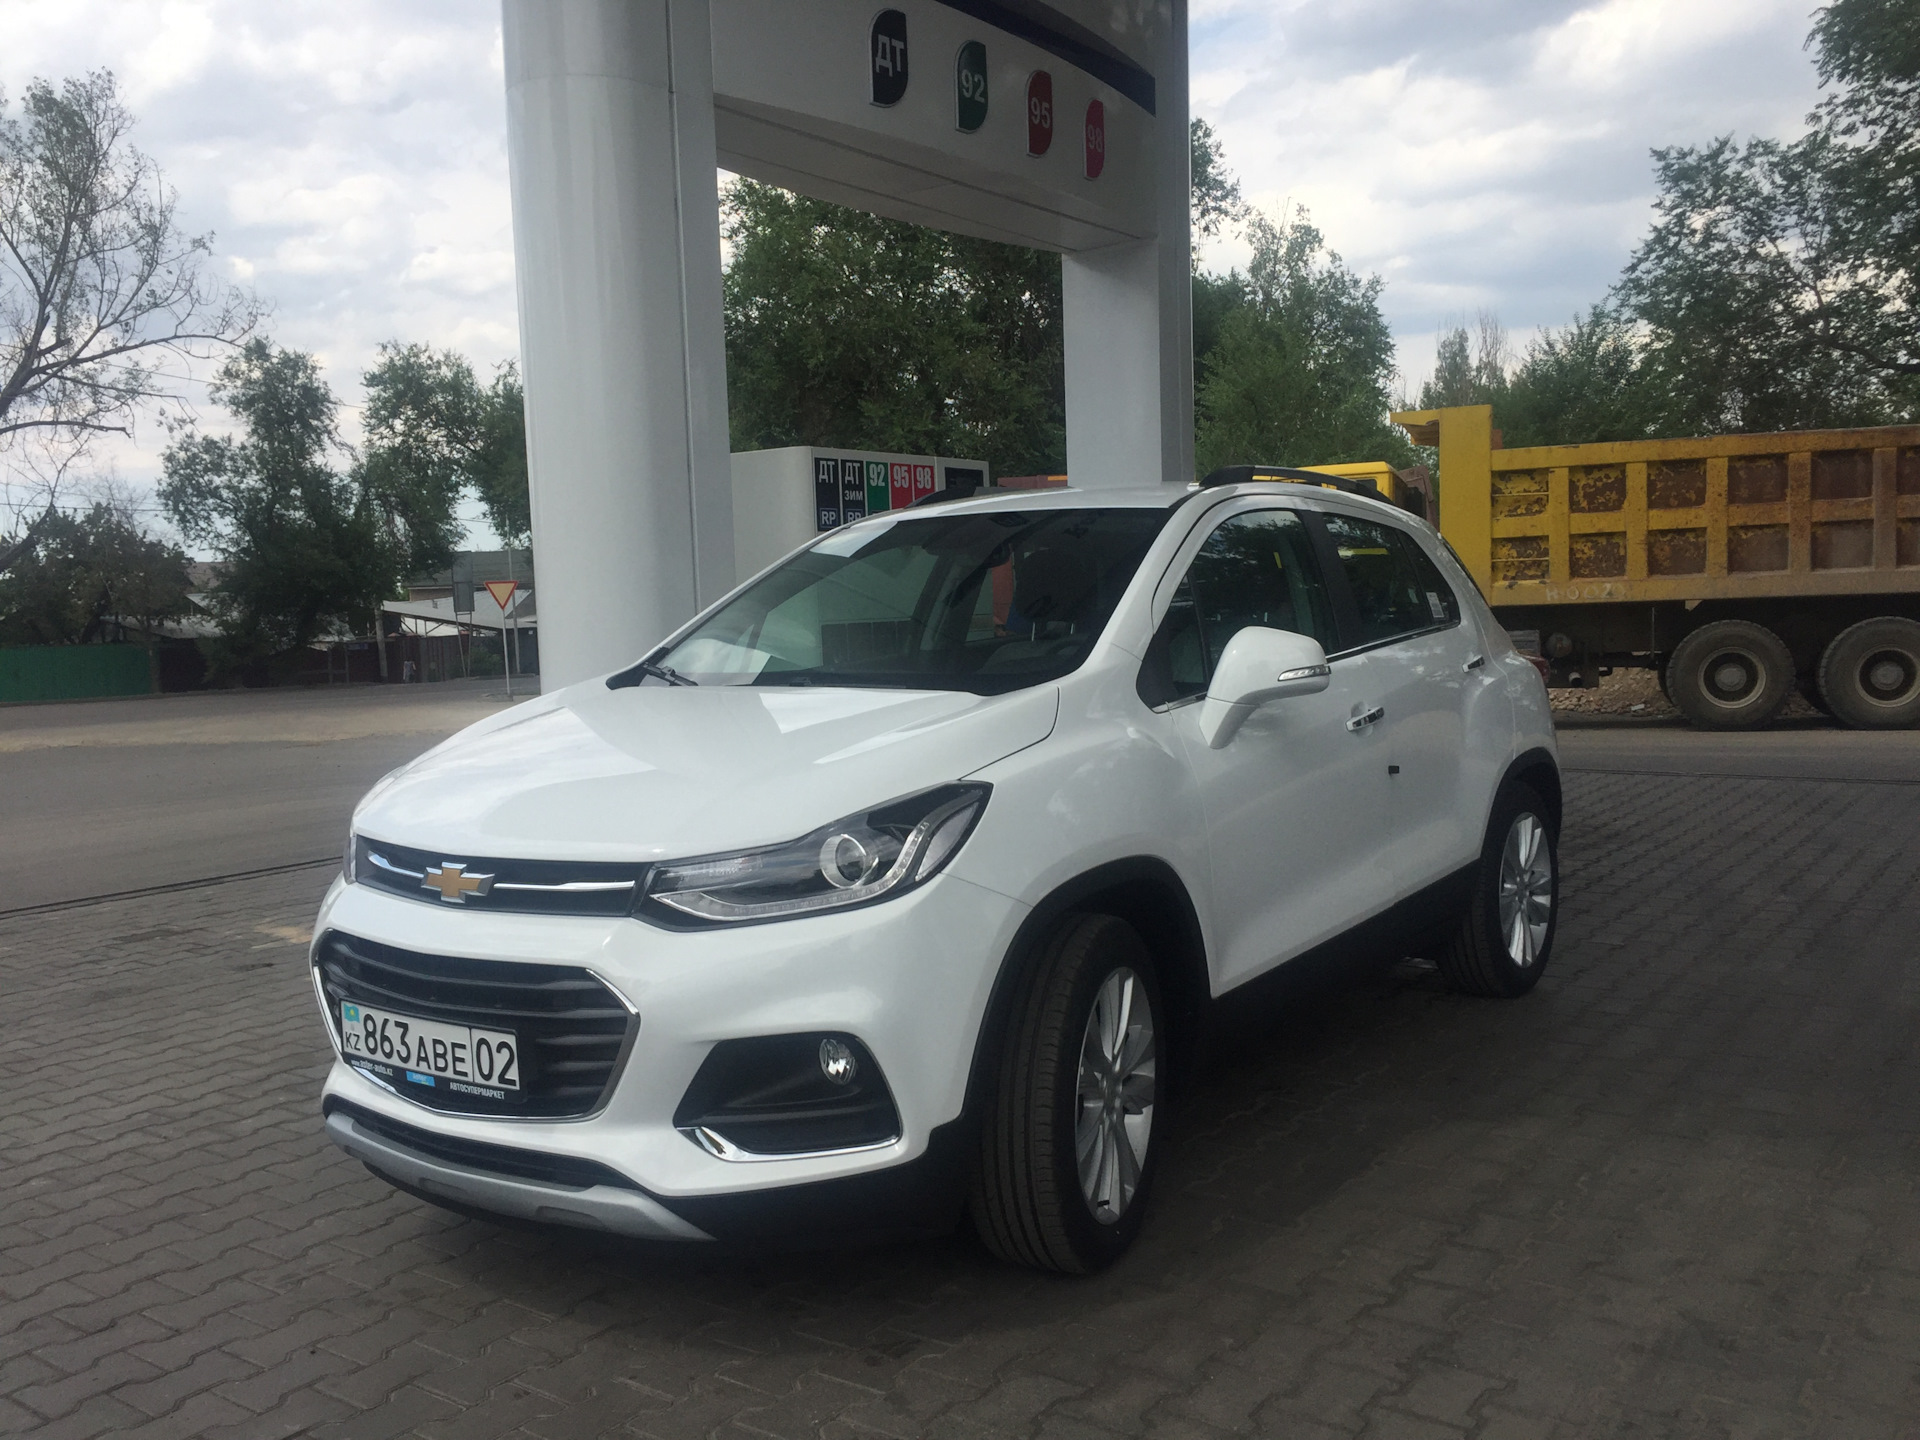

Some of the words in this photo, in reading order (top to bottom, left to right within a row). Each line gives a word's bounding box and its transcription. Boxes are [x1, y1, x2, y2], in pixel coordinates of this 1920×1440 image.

[875, 34, 905, 78] ДТ
[961, 69, 986, 104] 92
[1030, 97, 1051, 129] 95
[1087, 124, 1103, 153] 98
[818, 461, 835, 484] ДТ
[844, 462, 861, 485] ДТ
[869, 463, 886, 487] 92
[893, 465, 910, 489] 95
[916, 466, 932, 489] 98
[821, 510, 837, 525] RP
[344, 1031, 361, 1052] KZ
[449, 1081, 505, 1100] АВТОСУПЕРМАРКЕТ
